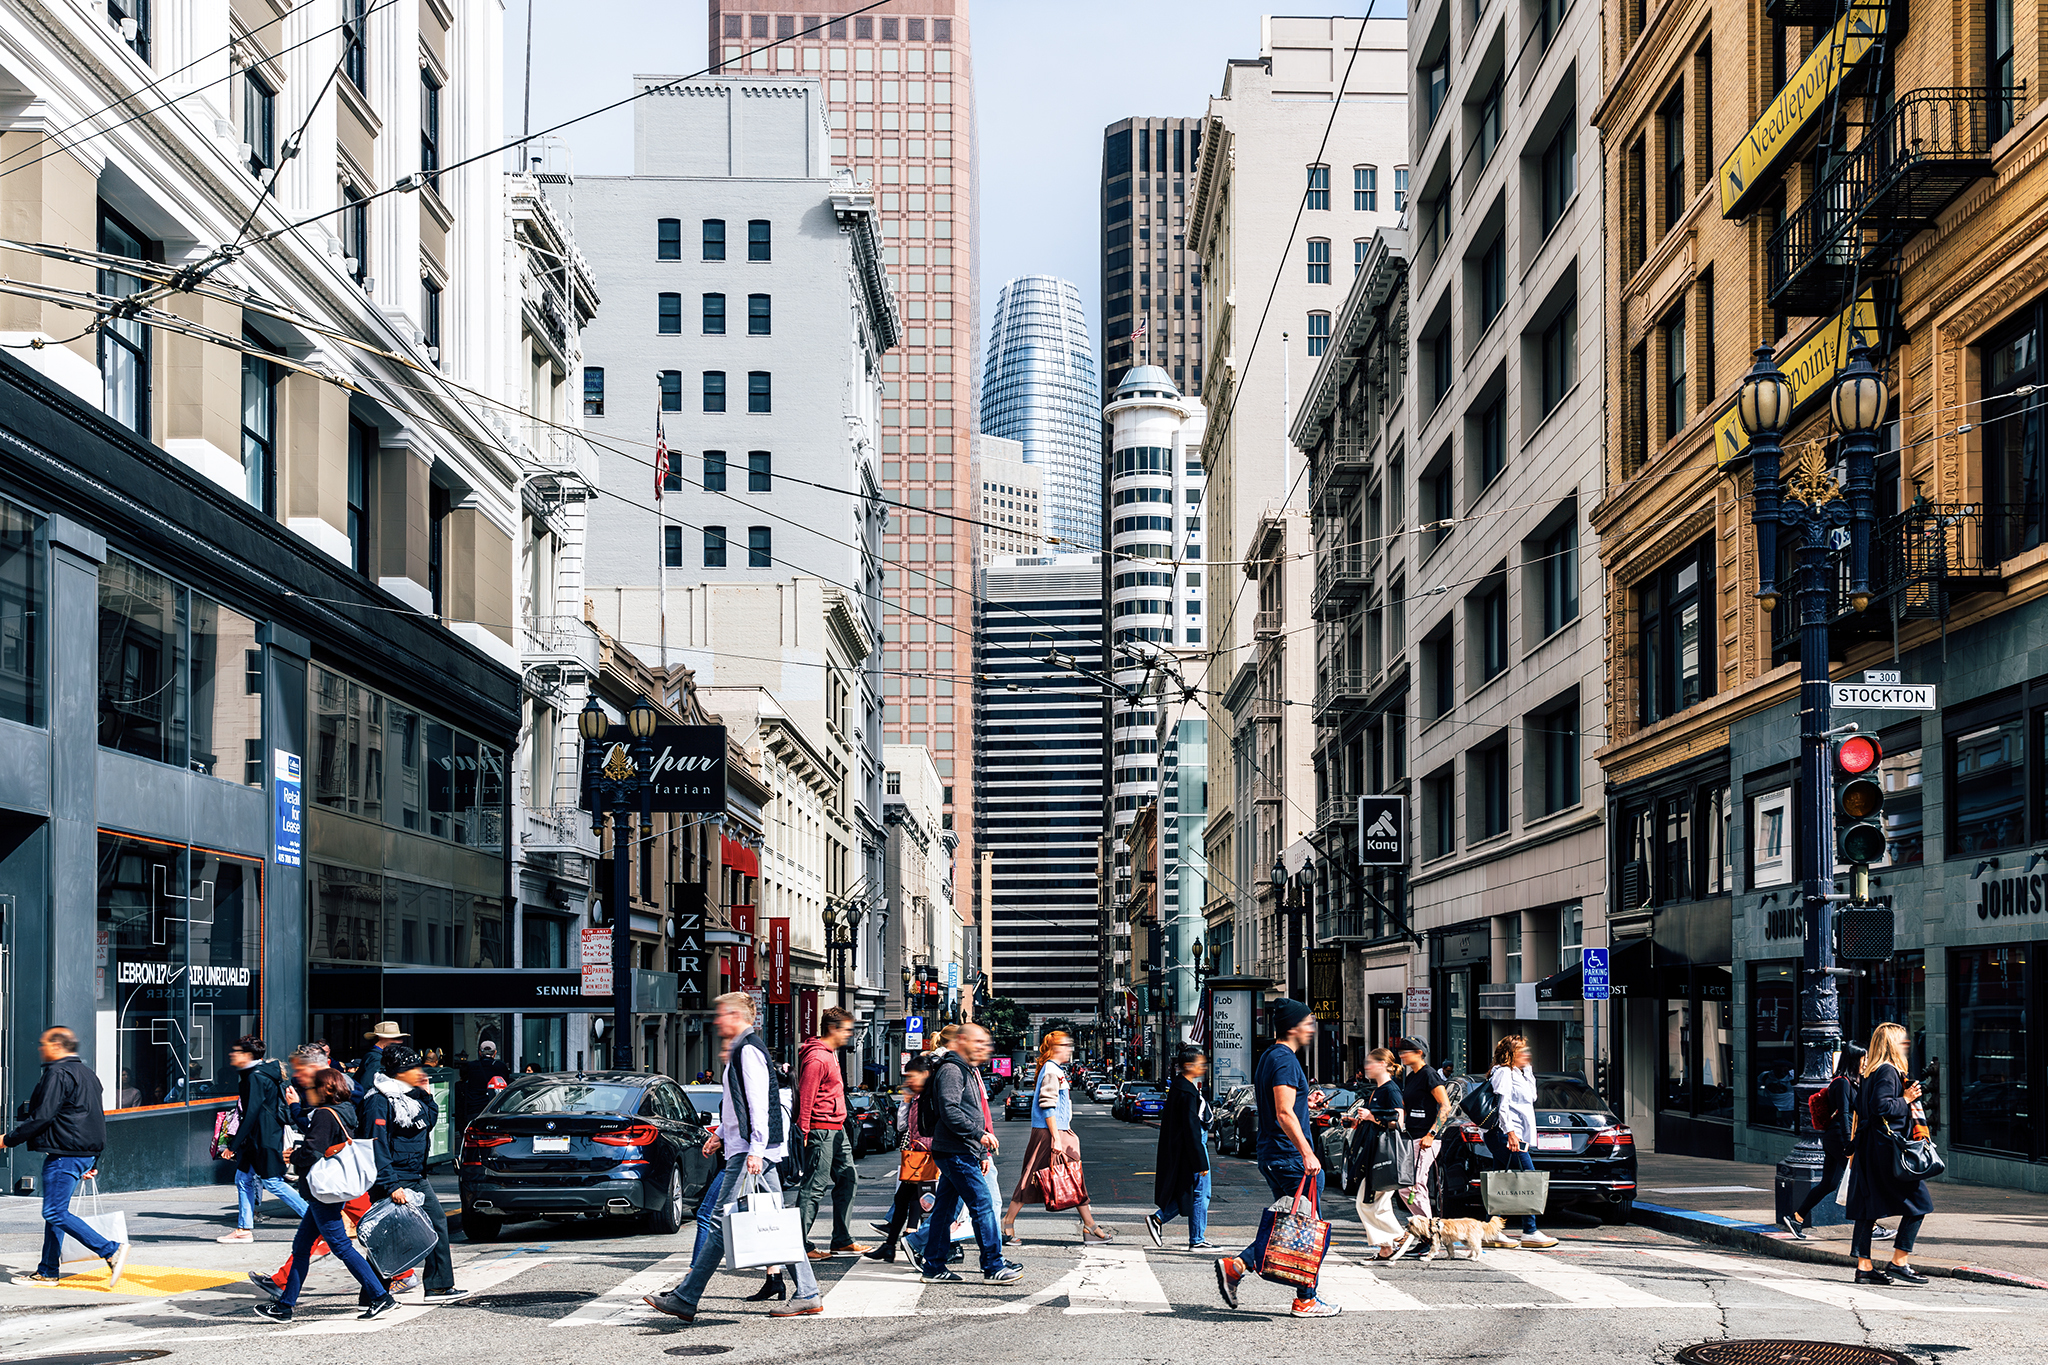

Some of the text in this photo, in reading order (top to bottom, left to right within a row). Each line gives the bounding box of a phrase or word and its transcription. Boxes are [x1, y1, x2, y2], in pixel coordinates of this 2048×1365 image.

[1880, 673, 1897, 682] 300
[1838, 688, 1926, 703] STOCKTON
[655, 783, 711, 794] farian
[283, 786, 300, 806] Retail
[291, 805, 300, 821] for
[282, 815, 300, 835] Lease
[1367, 840, 1398, 852] Kong
[582, 934, 591, 942] NO
[677, 913, 702, 994] ZARA
[738, 914, 748, 991] GMPS
[117, 961, 156, 984] LEBRON
[156, 964, 167, 985] 17
[189, 965, 204, 986] AIR
[204, 966, 250, 987] UNRIVALED
[582, 967, 592, 975] NO
[1584, 968, 1608, 976] PARKING
[1588, 976, 1603, 985] ONLY
[1218, 996, 1233, 1005] Lob
[1313, 1001, 1337, 1011] ART
[1214, 1020, 1236, 1032] Bring
[1143, 1025, 1152, 1056] MaxMara
[1214, 1030, 1243, 1041] Offline,
[1214, 1040, 1243, 1049] Online.
